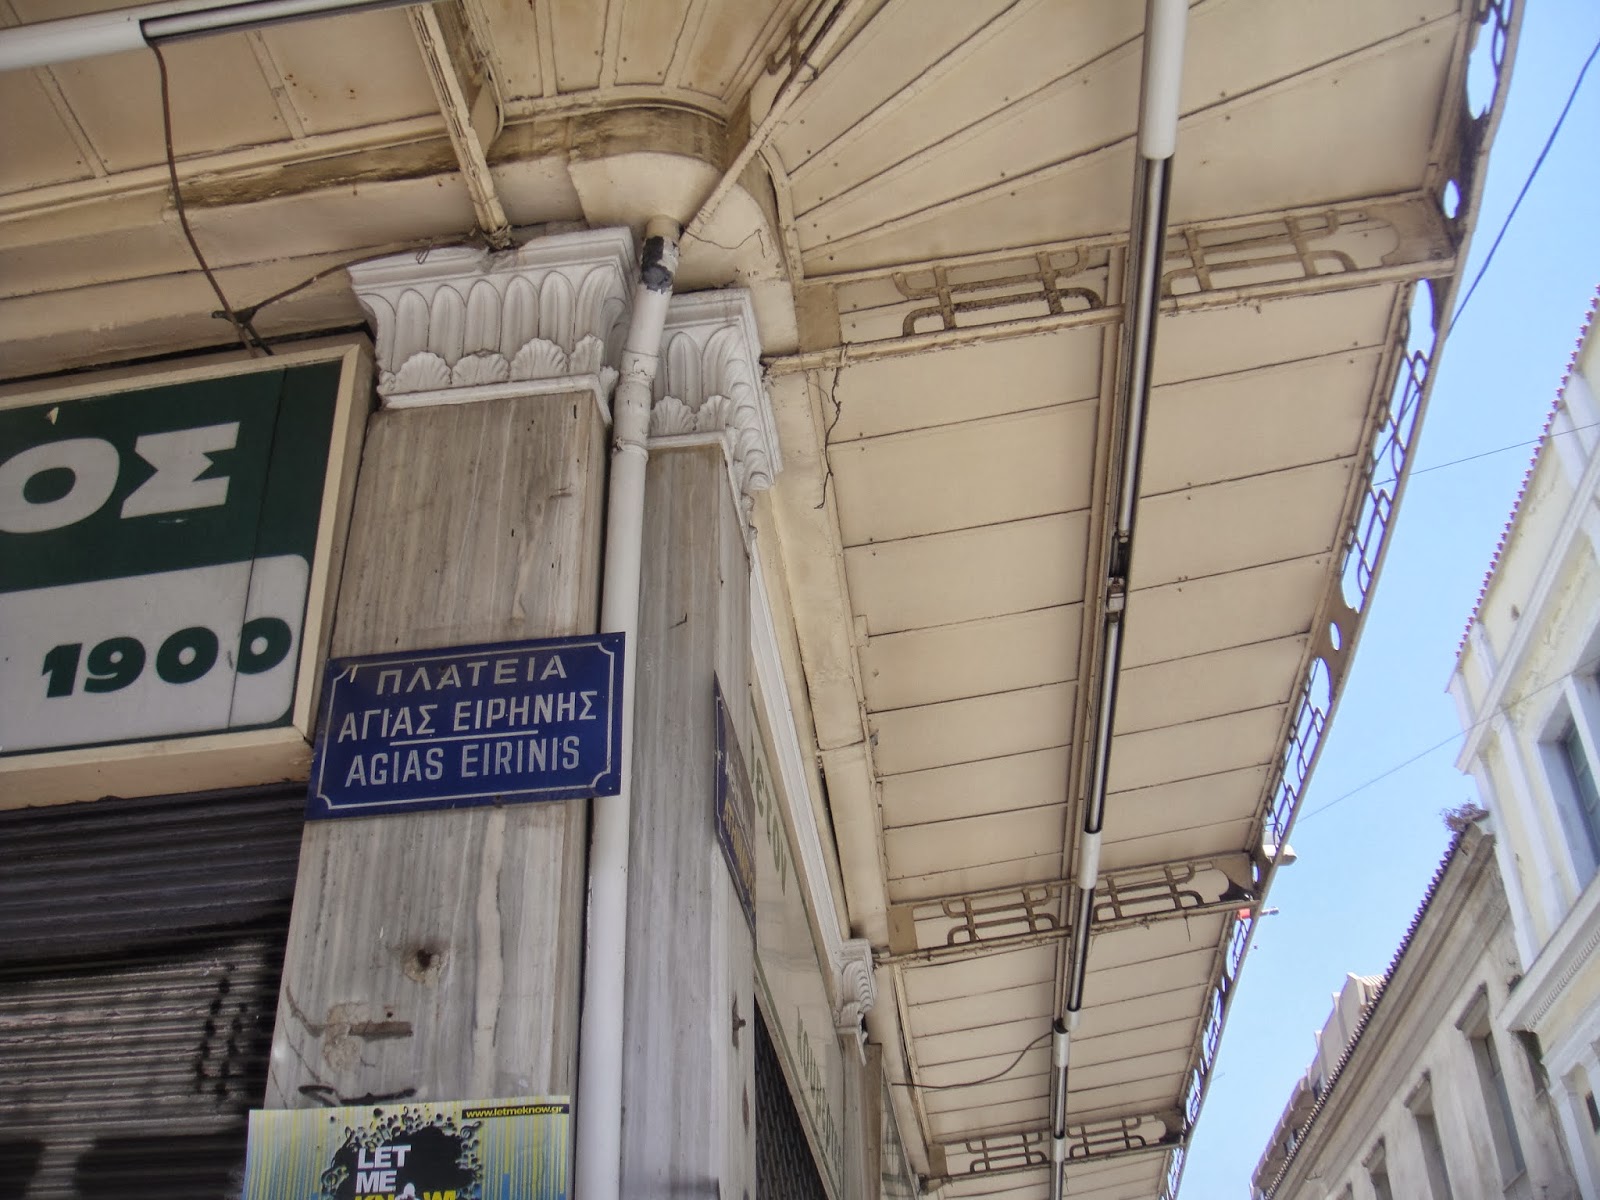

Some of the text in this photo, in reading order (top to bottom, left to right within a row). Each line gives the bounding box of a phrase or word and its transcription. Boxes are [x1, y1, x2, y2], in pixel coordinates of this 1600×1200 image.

[42, 617, 292, 699] 1900
[376, 655, 567, 695] ΠΛΑΤΕΙΑ
[337, 690, 597, 743] ΑΓΙΑΣ ΕΙΡΗΝΗΣ
[344, 735, 580, 787] AGIAS EIRINIS
[466, 1105, 564, 1119] www.letmeknow.gr
[357, 1144, 412, 1169] LET
[355, 1170, 397, 1194] ME
